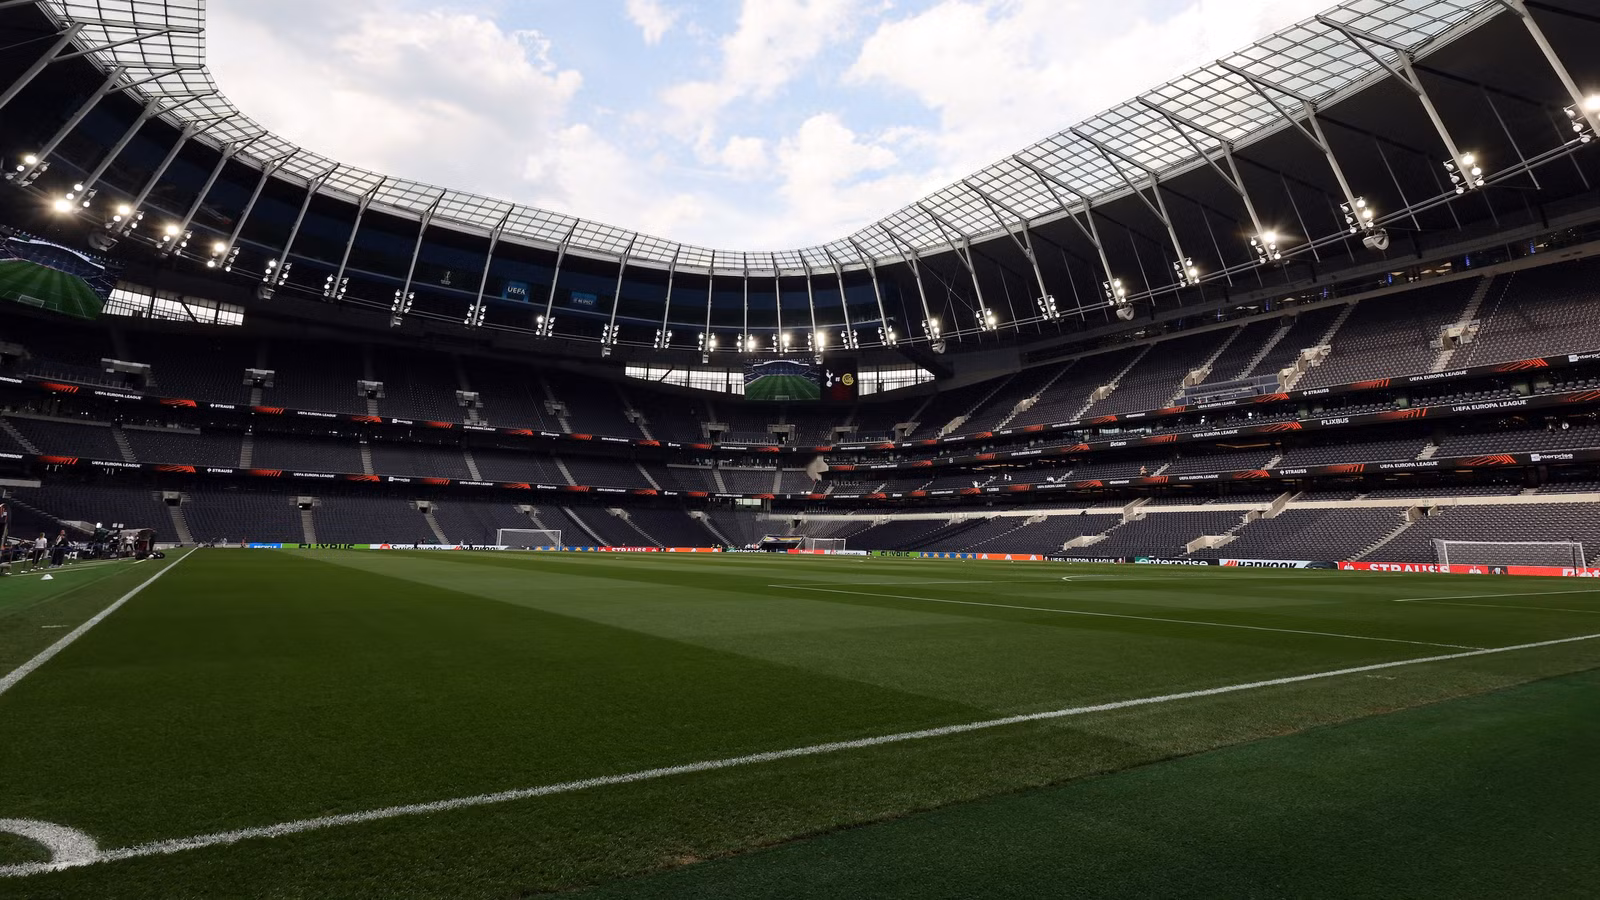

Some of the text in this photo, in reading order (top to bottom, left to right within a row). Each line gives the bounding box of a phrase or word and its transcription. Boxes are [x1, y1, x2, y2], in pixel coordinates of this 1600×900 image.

[507, 286, 526, 295] UEFA
[1321, 418, 1349, 426] FLIXBUS
[1138, 557, 1209, 566] enterprise
[1369, 563, 1449, 573] STRAUSS
